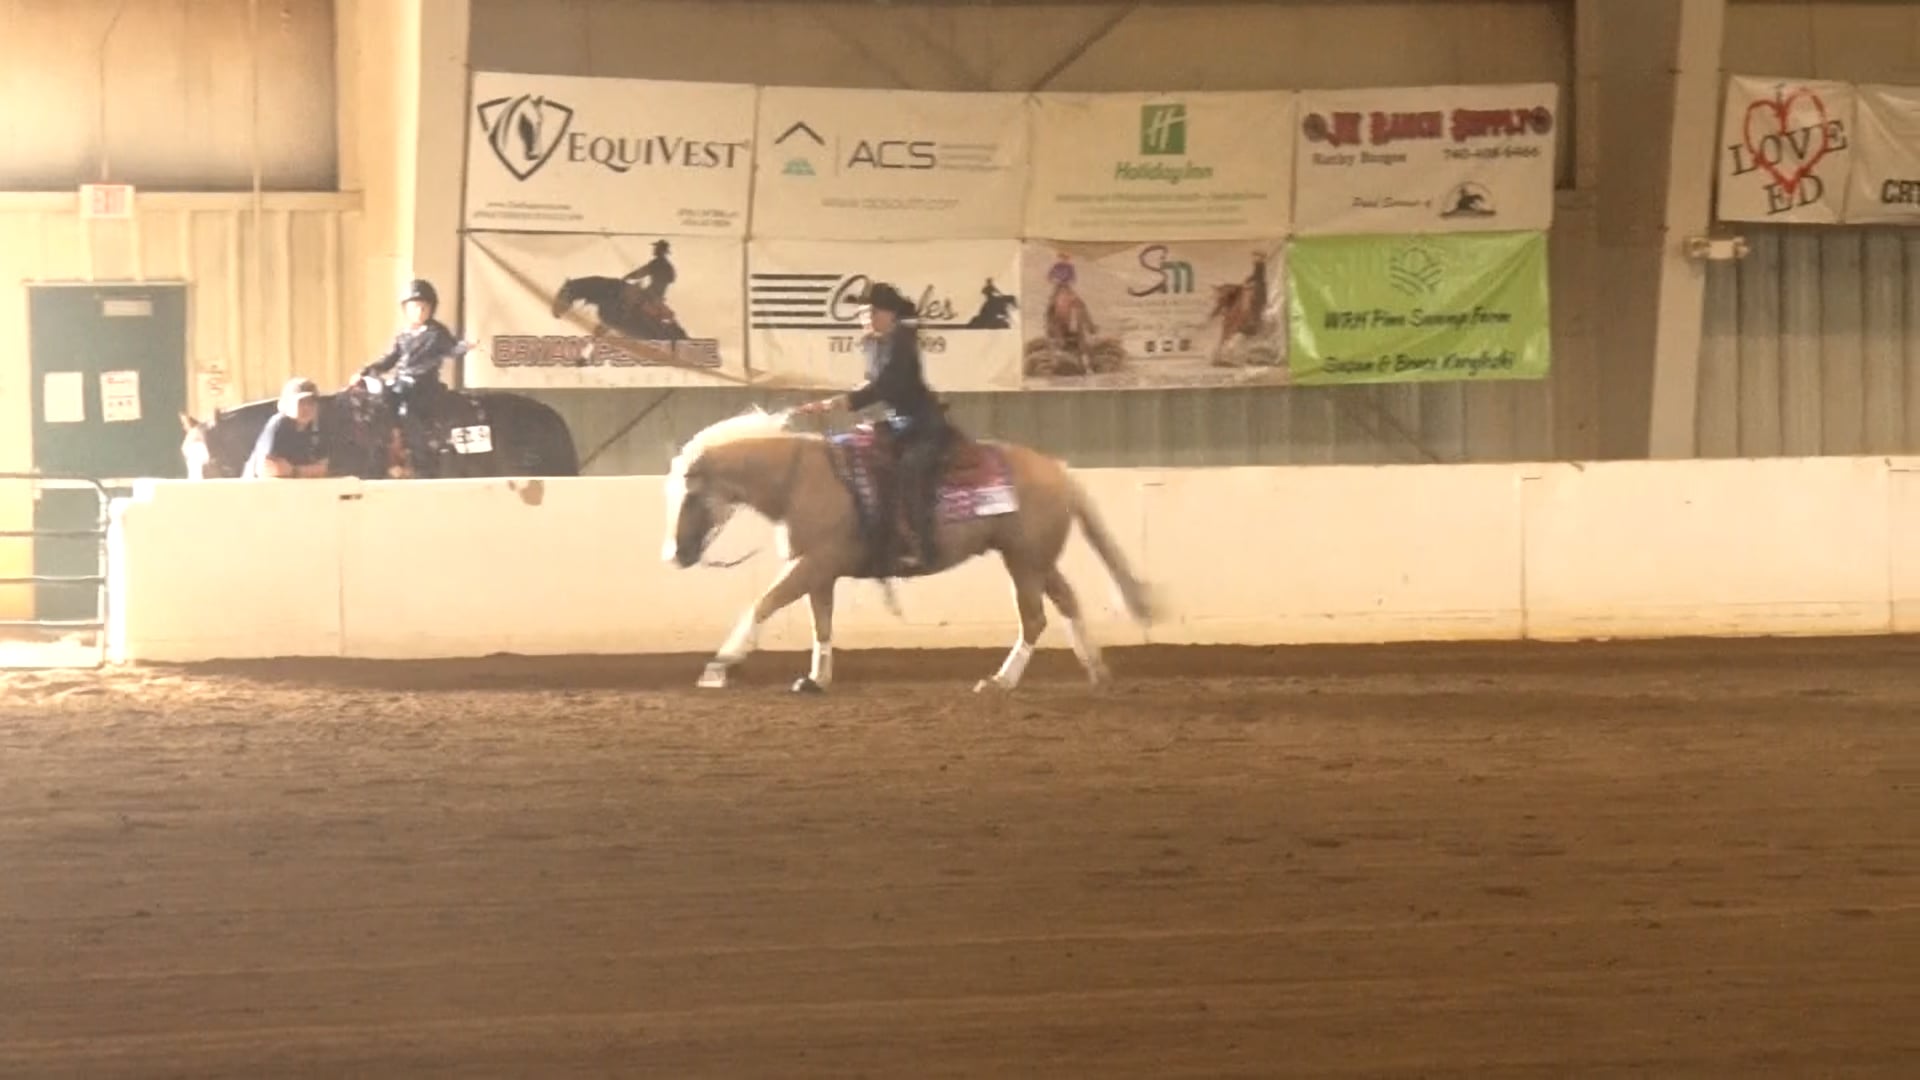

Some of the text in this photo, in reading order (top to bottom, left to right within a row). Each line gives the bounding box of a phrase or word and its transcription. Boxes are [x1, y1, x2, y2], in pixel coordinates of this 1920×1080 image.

[847, 140, 936, 169] ACS
[1727, 120, 1848, 177] LOVE
[1762, 174, 1825, 215] ED
[831, 274, 958, 321] Cles
